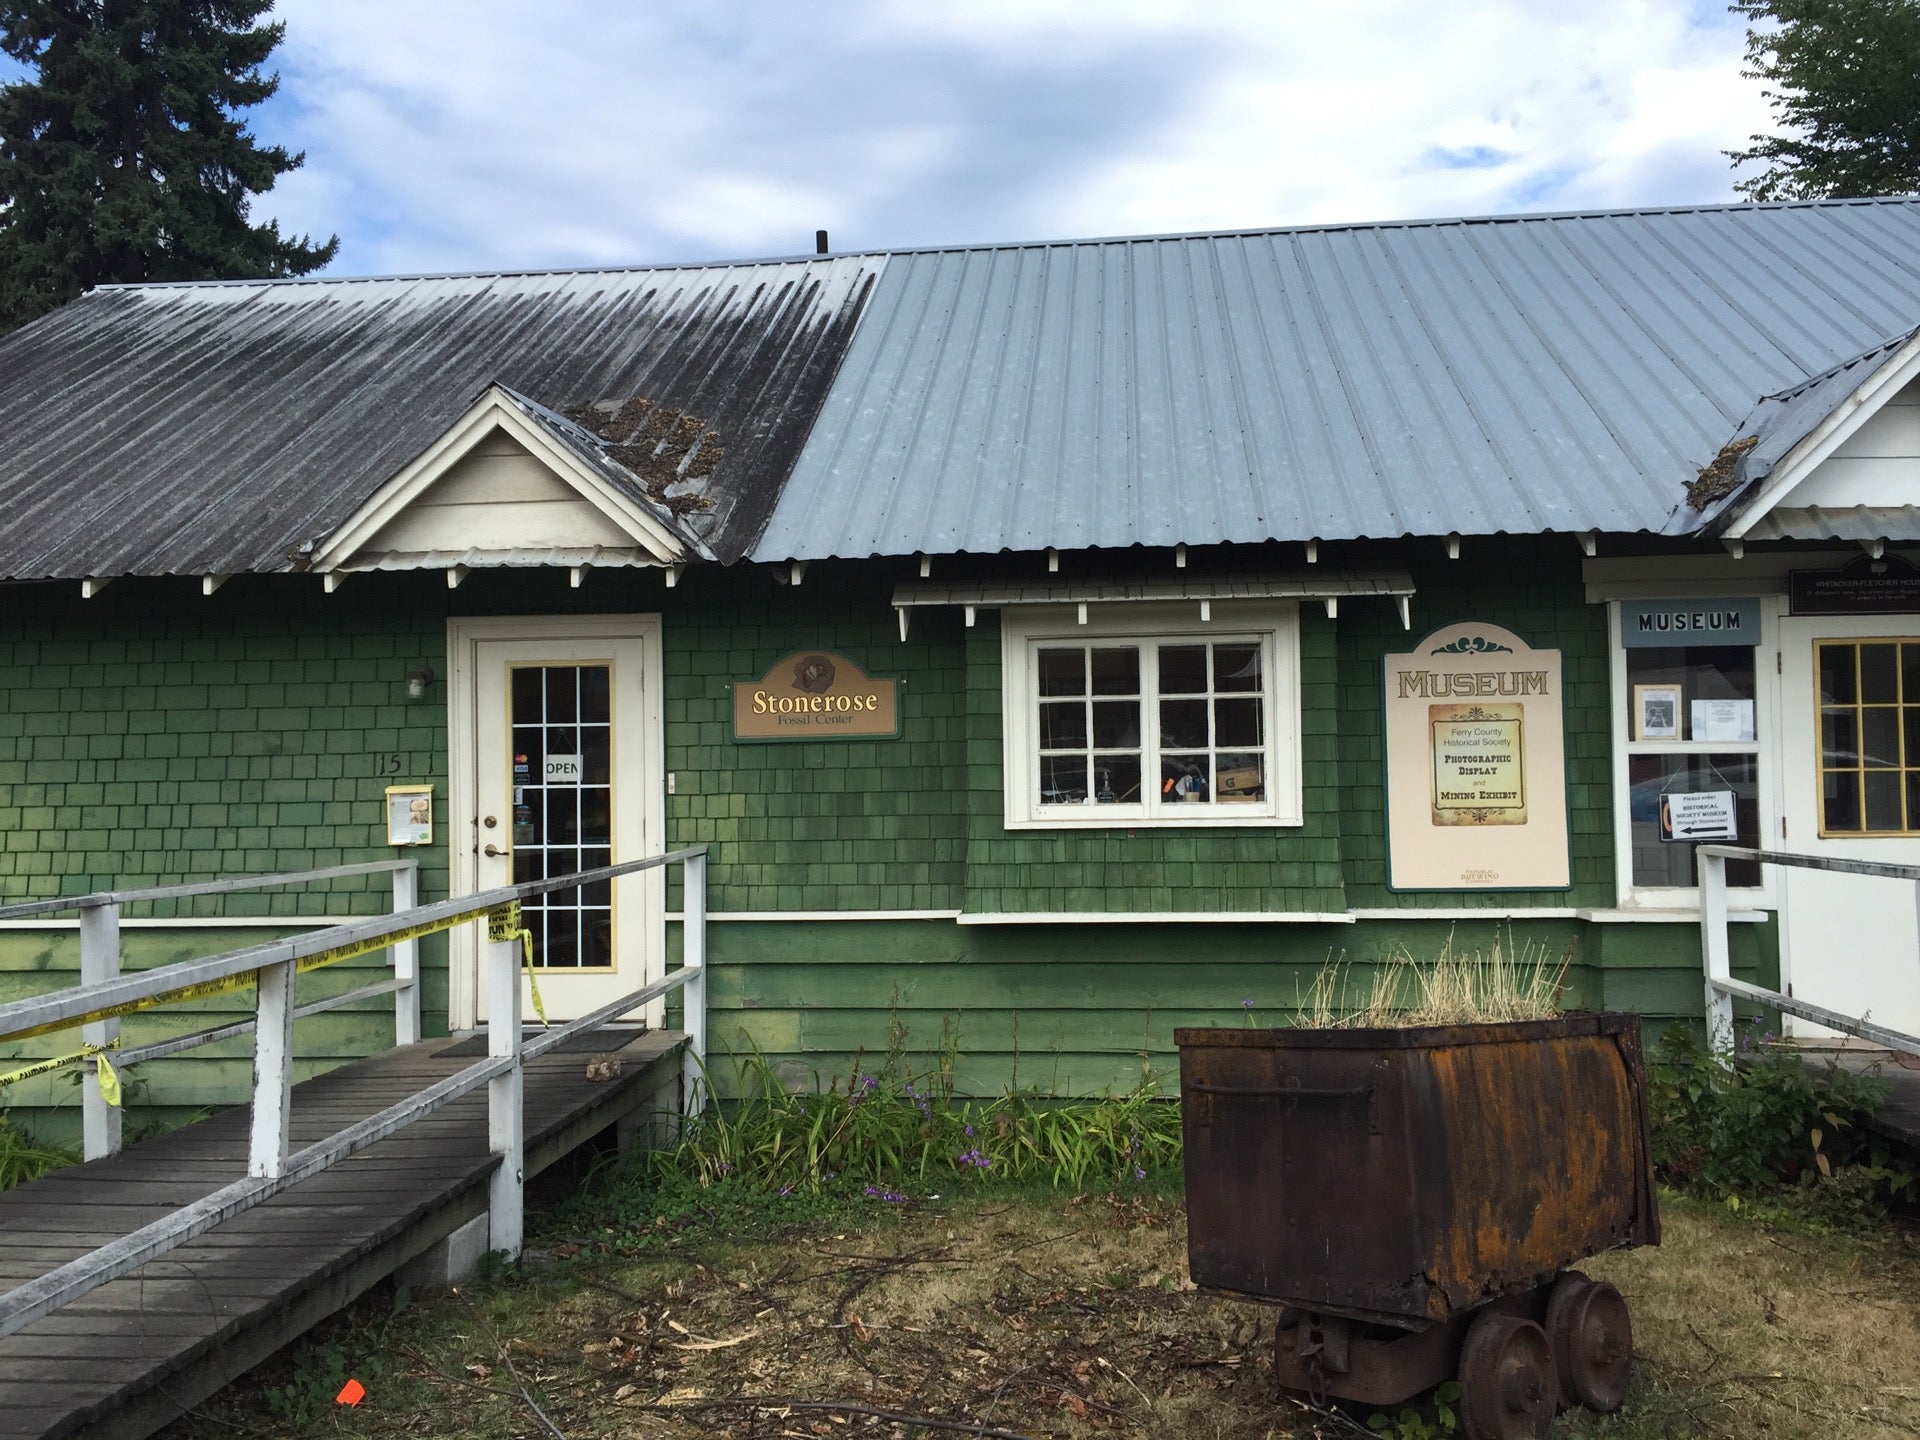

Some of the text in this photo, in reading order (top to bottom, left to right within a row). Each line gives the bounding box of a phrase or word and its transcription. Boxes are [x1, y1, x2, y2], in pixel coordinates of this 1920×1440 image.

[1639, 612, 1740, 631] MUSEUM
[1396, 670, 1550, 698] MUSEUM
[752, 690, 878, 714] Stonerose
[778, 713, 854, 725] Fossil Center
[1451, 727, 1503, 738] Ferry County
[1443, 738, 1511, 748] Historical Society
[1444, 754, 1512, 764] PHOTOGRAPHIC
[546, 763, 578, 774] OPEN
[1458, 766, 1498, 776] DISPLAY
[1440, 790, 1518, 800] MINING EXHIBIT
[1682, 803, 1719, 811] HISTORICAL
